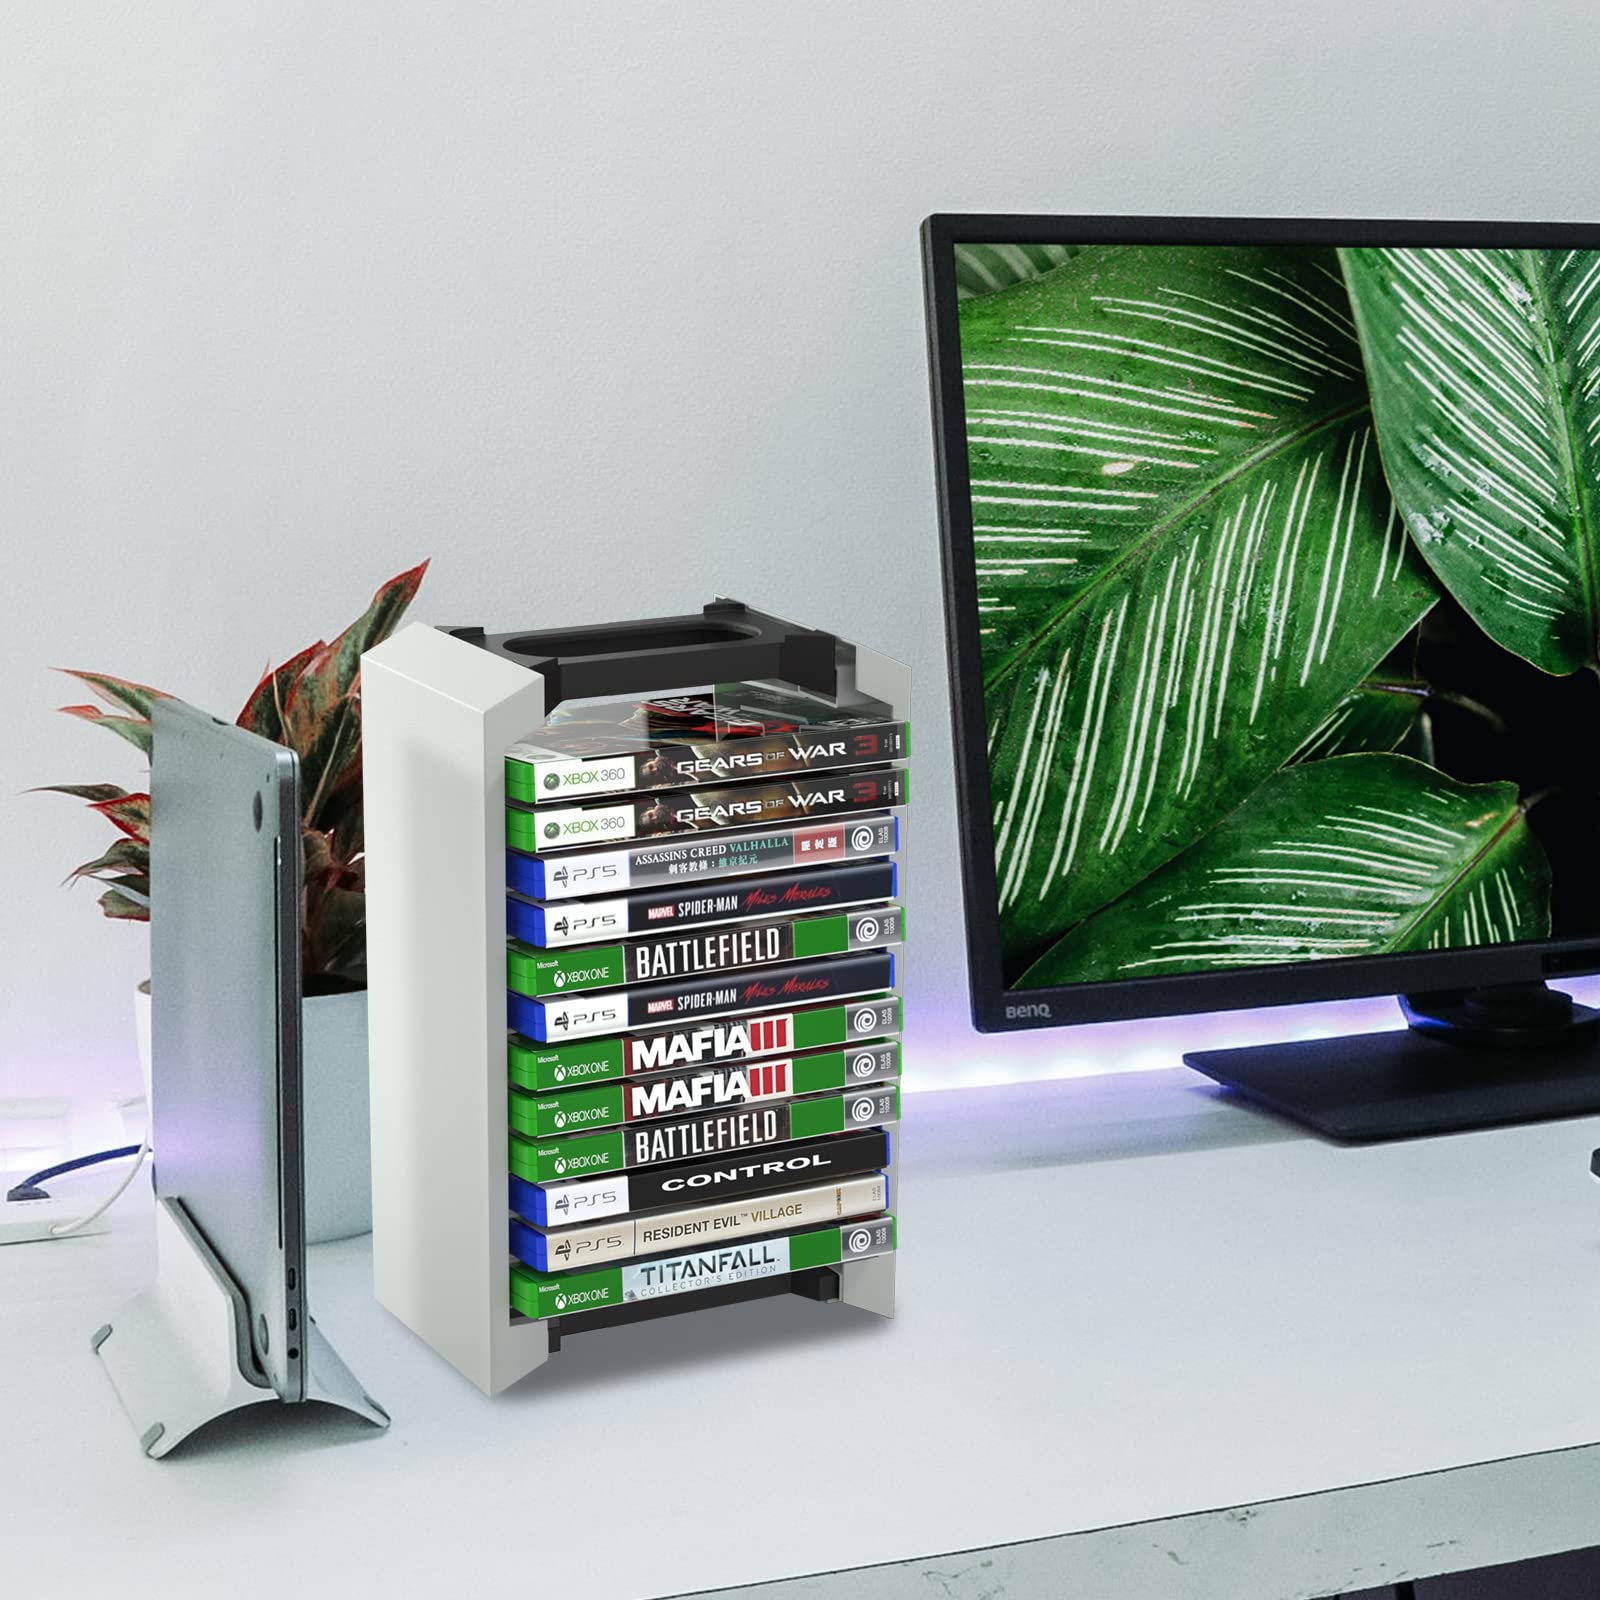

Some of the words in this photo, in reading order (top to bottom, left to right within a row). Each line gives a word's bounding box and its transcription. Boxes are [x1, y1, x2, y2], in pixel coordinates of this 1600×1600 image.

[676, 752, 763, 774] GEARS
[765, 751, 786, 761] OF
[788, 742, 847, 761] WAR
[853, 734, 878, 756] 3
[562, 771, 599, 786] XBOX
[600, 767, 626, 782] 360
[676, 800, 762, 823] GEARS
[764, 799, 785, 809] OF
[787, 789, 846, 808] WAR
[852, 781, 877, 803] 3
[562, 819, 599, 835] XBOX
[600, 816, 626, 831] 360
[635, 849, 687, 866] ASSASSINS
[690, 844, 727, 858] CREED
[729, 837, 789, 853] VALHALLA
[573, 865, 618, 881] PS5
[648, 905, 674, 920] MARVEL
[678, 896, 738, 918] SPIDER-MAN
[573, 914, 617, 931] PS5
[636, 928, 780, 979] BATTLEFIELD
[537, 960, 559, 970] Microsoft
[647, 999, 674, 1014] MARVEL
[677, 988, 737, 1011] SPIDER-MAN
[1005, 1003, 1052, 1019] BenQ
[573, 1009, 616, 1025] PS5
[632, 1025, 752, 1071] MAFIA
[750, 1018, 788, 1051] III
[537, 1054, 559, 1064] Microsoft
[632, 1071, 752, 1117] MAFIA
[749, 1064, 787, 1097] III
[537, 1101, 559, 1111] Microsoft
[635, 1110, 776, 1163] BATTLEFIELD
[538, 1147, 560, 1156] Microsoft
[661, 1154, 832, 1192] CONTROL
[574, 1191, 617, 1208] PS5
[643, 1220, 710, 1243] RESIDENT
[751, 1203, 803, 1222] VILLAGE
[576, 1236, 622, 1253] PS5
[641, 1245, 776, 1286] TITANFALL
[539, 1284, 560, 1293] Microsoft
[641, 1275, 722, 1297] COLLECTOR'S
[728, 1265, 776, 1281] EDITION
